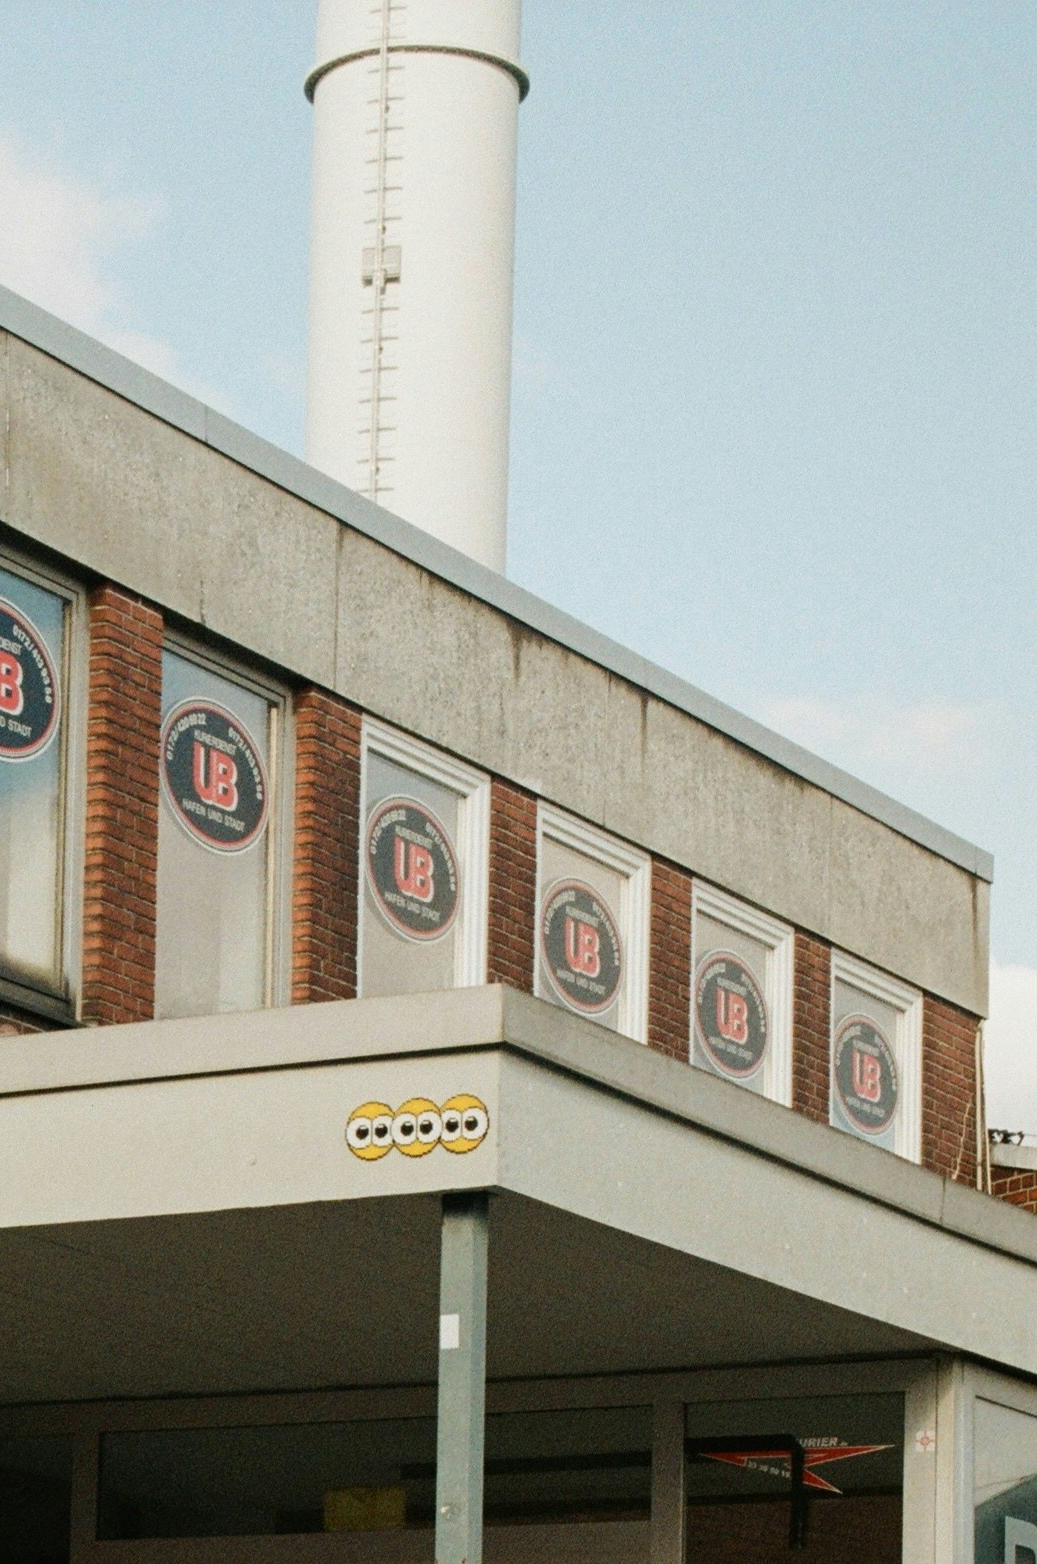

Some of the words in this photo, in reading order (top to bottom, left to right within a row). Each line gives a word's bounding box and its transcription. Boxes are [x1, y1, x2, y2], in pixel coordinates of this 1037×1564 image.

[8, 720, 32, 737] STADT
[193, 741, 239, 812] UB
[394, 836, 434, 903] UB
[565, 915, 600, 978] UB
[716, 985, 749, 1045] UB
[852, 1048, 882, 1103] UB
